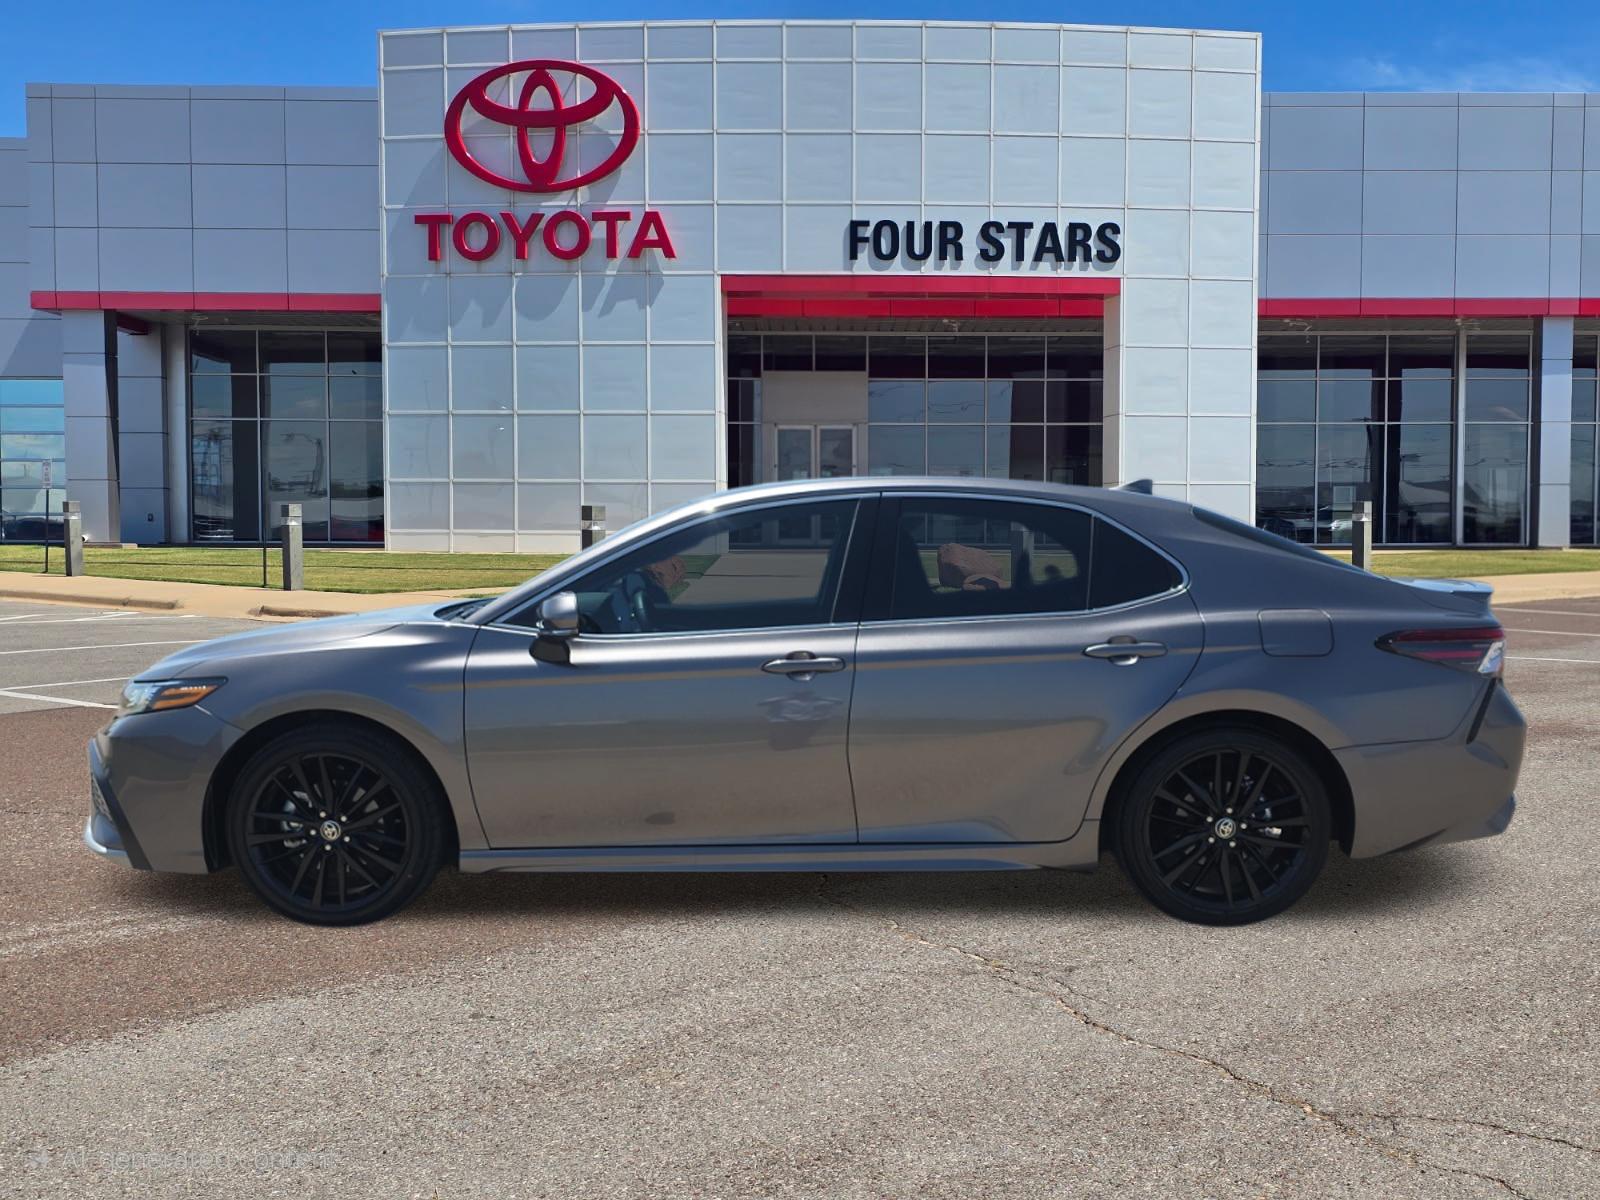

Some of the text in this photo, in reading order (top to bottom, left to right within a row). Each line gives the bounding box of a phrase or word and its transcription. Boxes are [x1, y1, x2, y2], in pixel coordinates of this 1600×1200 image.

[414, 211, 676, 261] TOYOTA
[849, 219, 1122, 263] FOUR STARS
